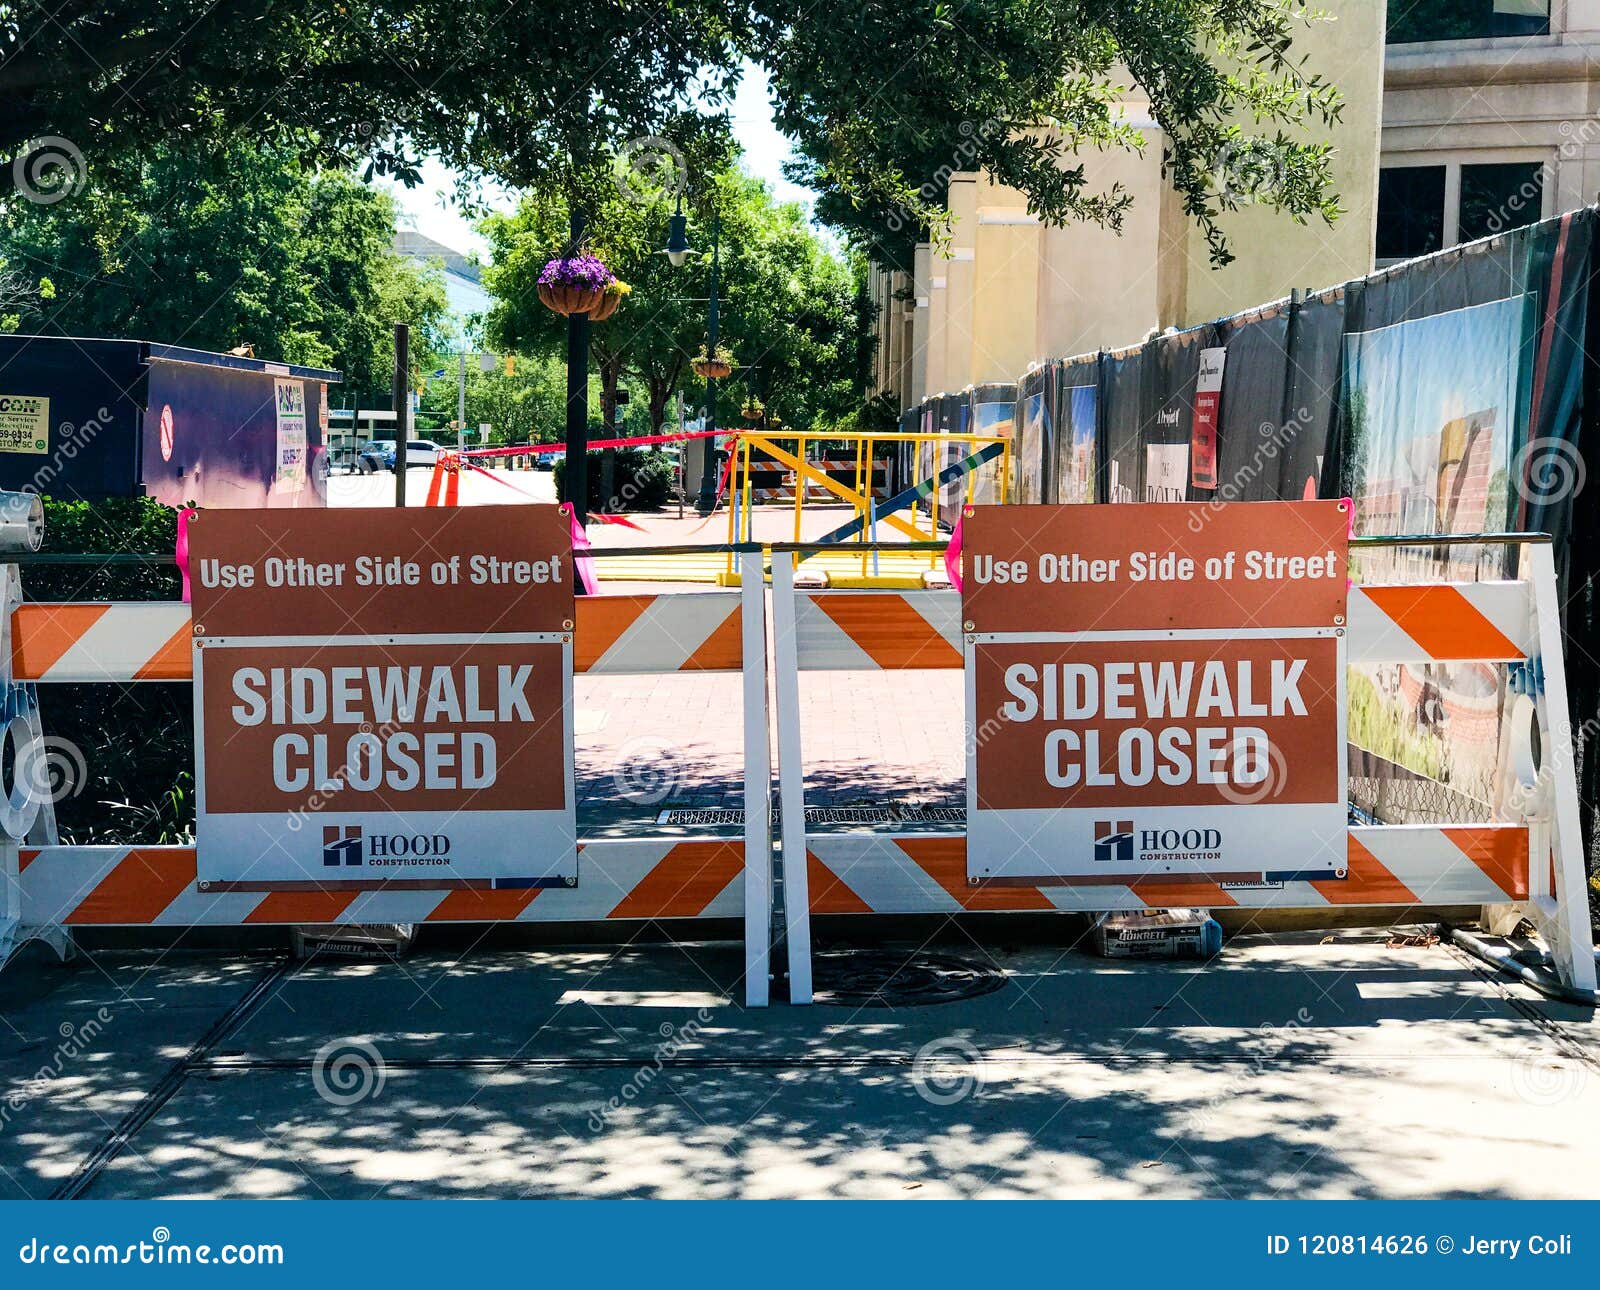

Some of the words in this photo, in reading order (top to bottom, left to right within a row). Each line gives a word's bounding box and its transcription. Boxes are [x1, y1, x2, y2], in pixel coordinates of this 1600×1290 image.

[200, 558, 255, 588] Use
[265, 557, 346, 587] Other
[355, 555, 421, 586] Side
[430, 555, 460, 585] of
[469, 554, 562, 585] Street
[973, 554, 1028, 585] Use
[1038, 552, 1120, 584] Other
[1129, 551, 1195, 582] Side
[1204, 550, 1236, 581] of
[1244, 550, 1337, 580] Street
[231, 664, 535, 726] SIDEWALK
[1003, 659, 1309, 722] SIDEWALK
[272, 732, 497, 793] CLOSED
[1044, 726, 1270, 788] CLOSED
[368, 834, 451, 857] HOOD
[1140, 829, 1222, 852] HOOD
[1140, 851, 1222, 861] CONSTRUCTION
[368, 858, 451, 867] CONSTRUCTION
